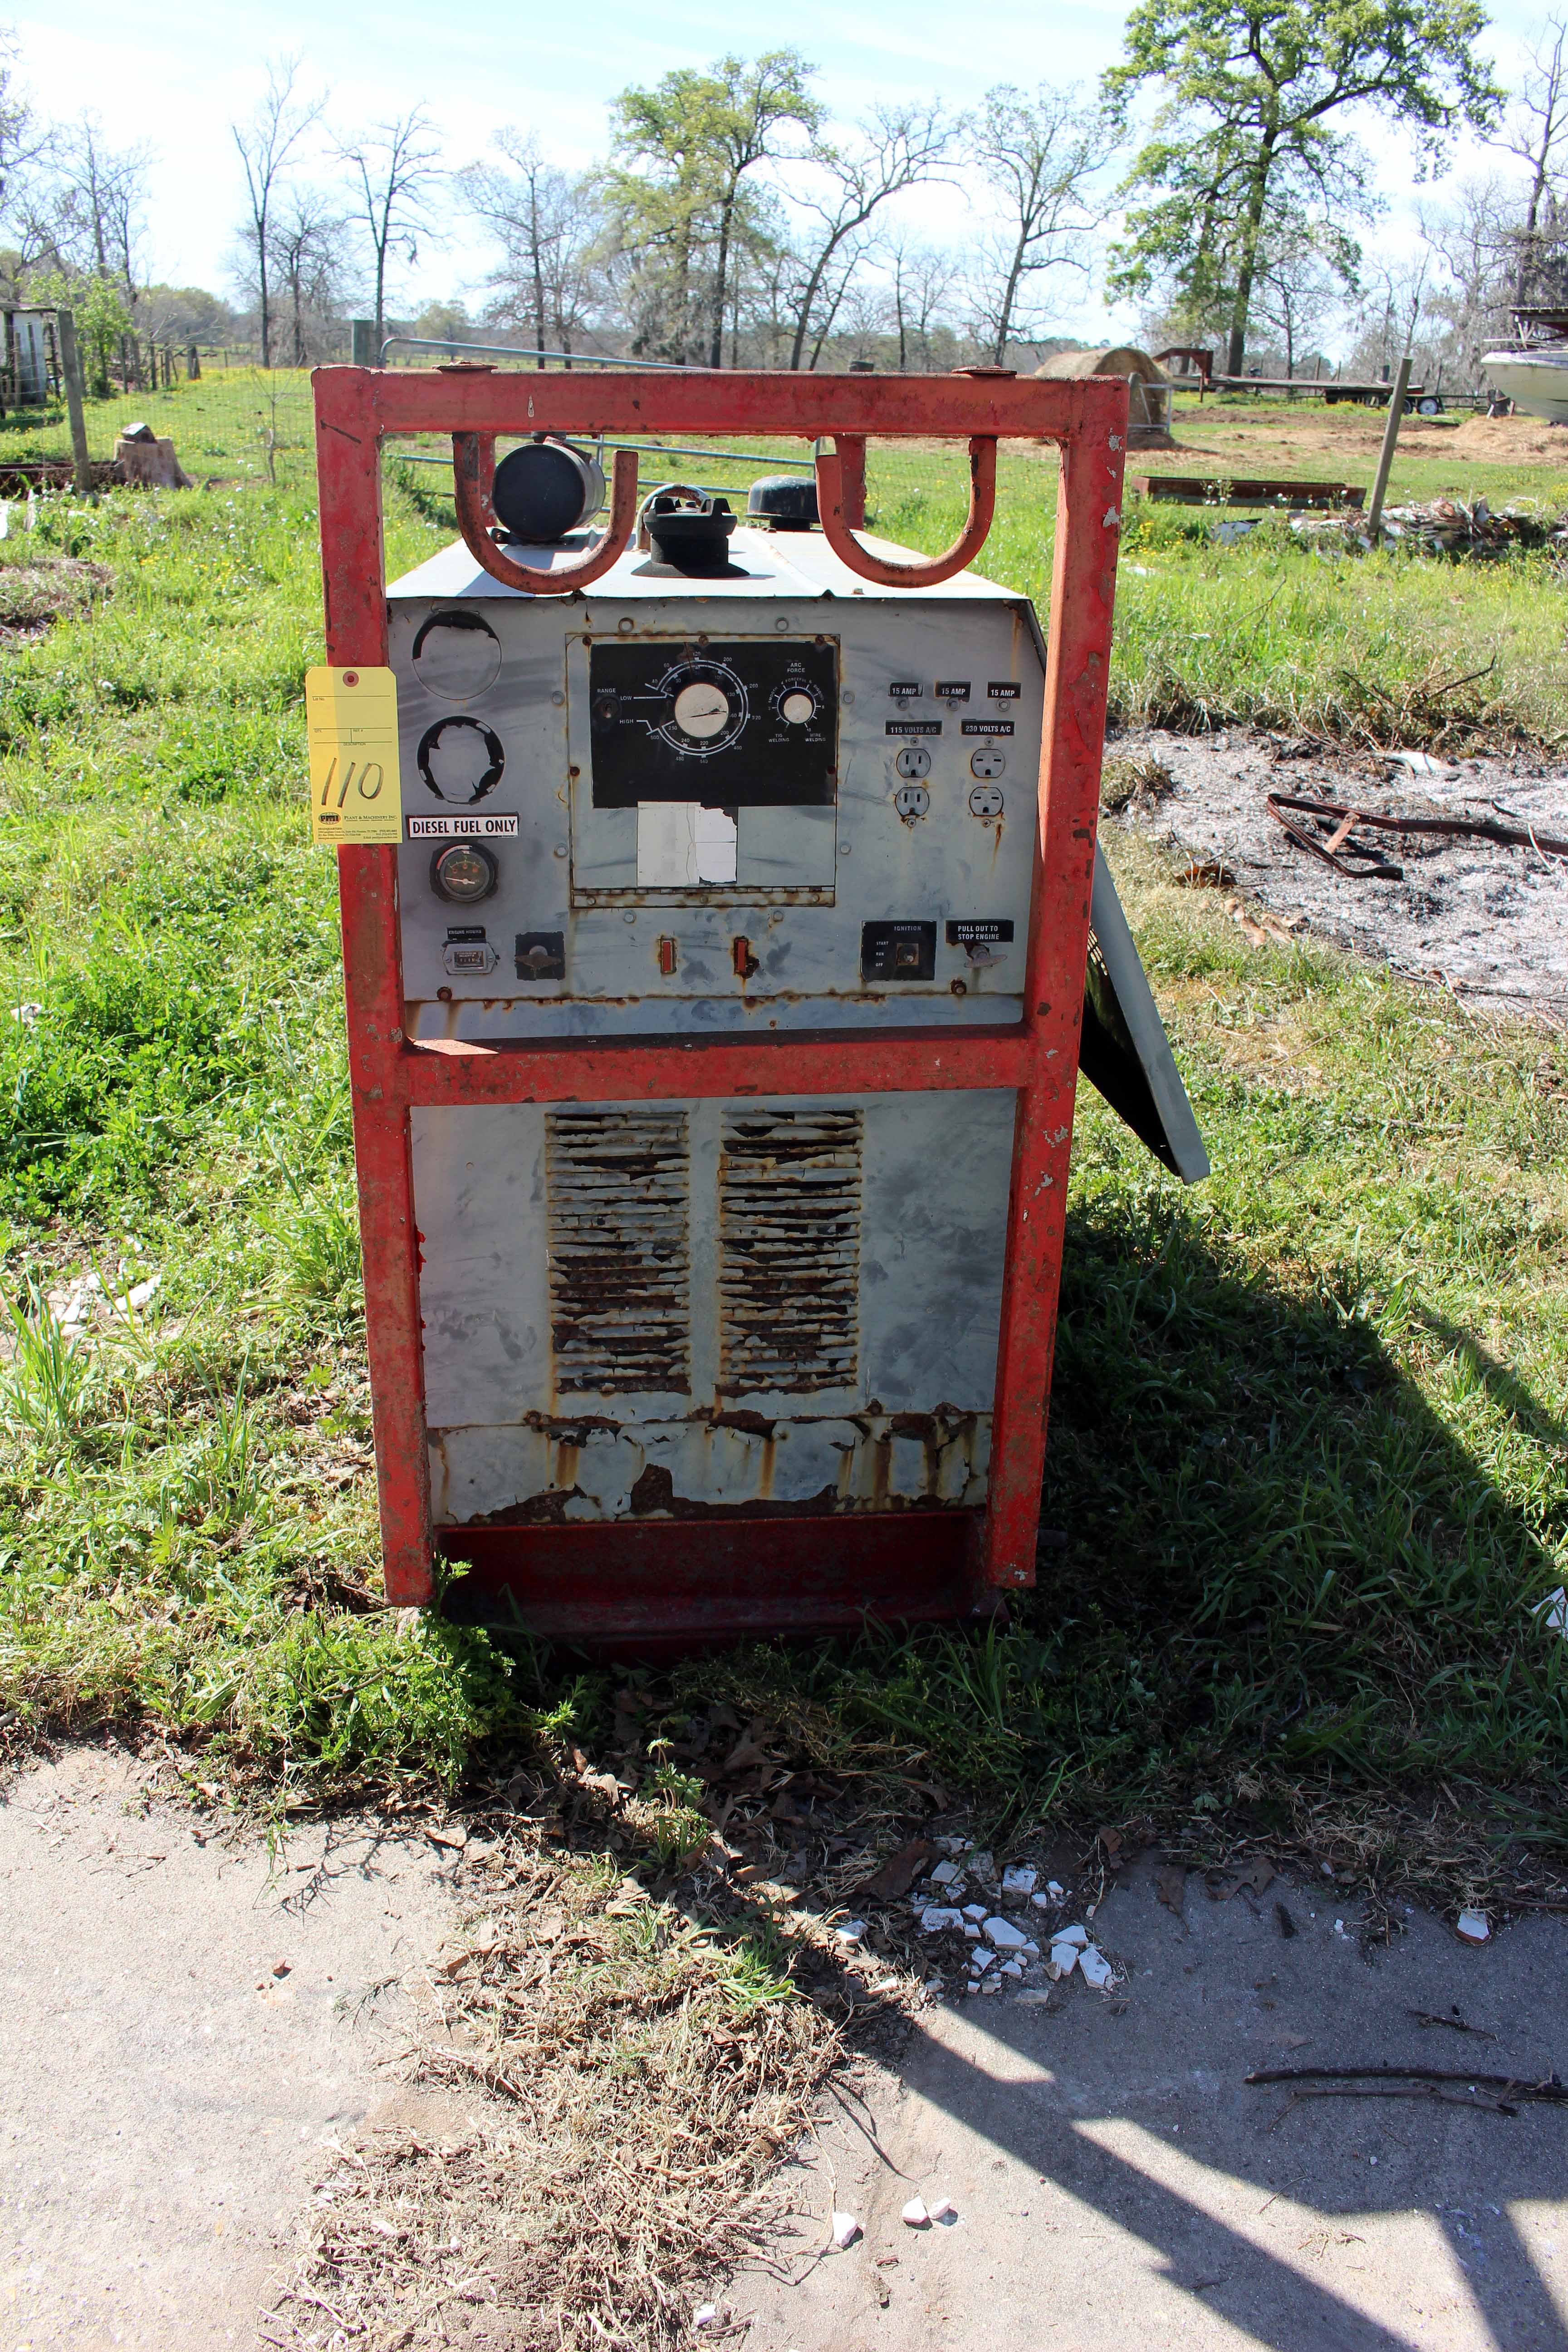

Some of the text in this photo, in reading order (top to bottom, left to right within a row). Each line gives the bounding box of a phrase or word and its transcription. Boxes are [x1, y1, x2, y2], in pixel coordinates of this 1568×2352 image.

[321, 758, 383, 808] 110
[413, 820, 515, 833] DIESEL FUEL ONLY
